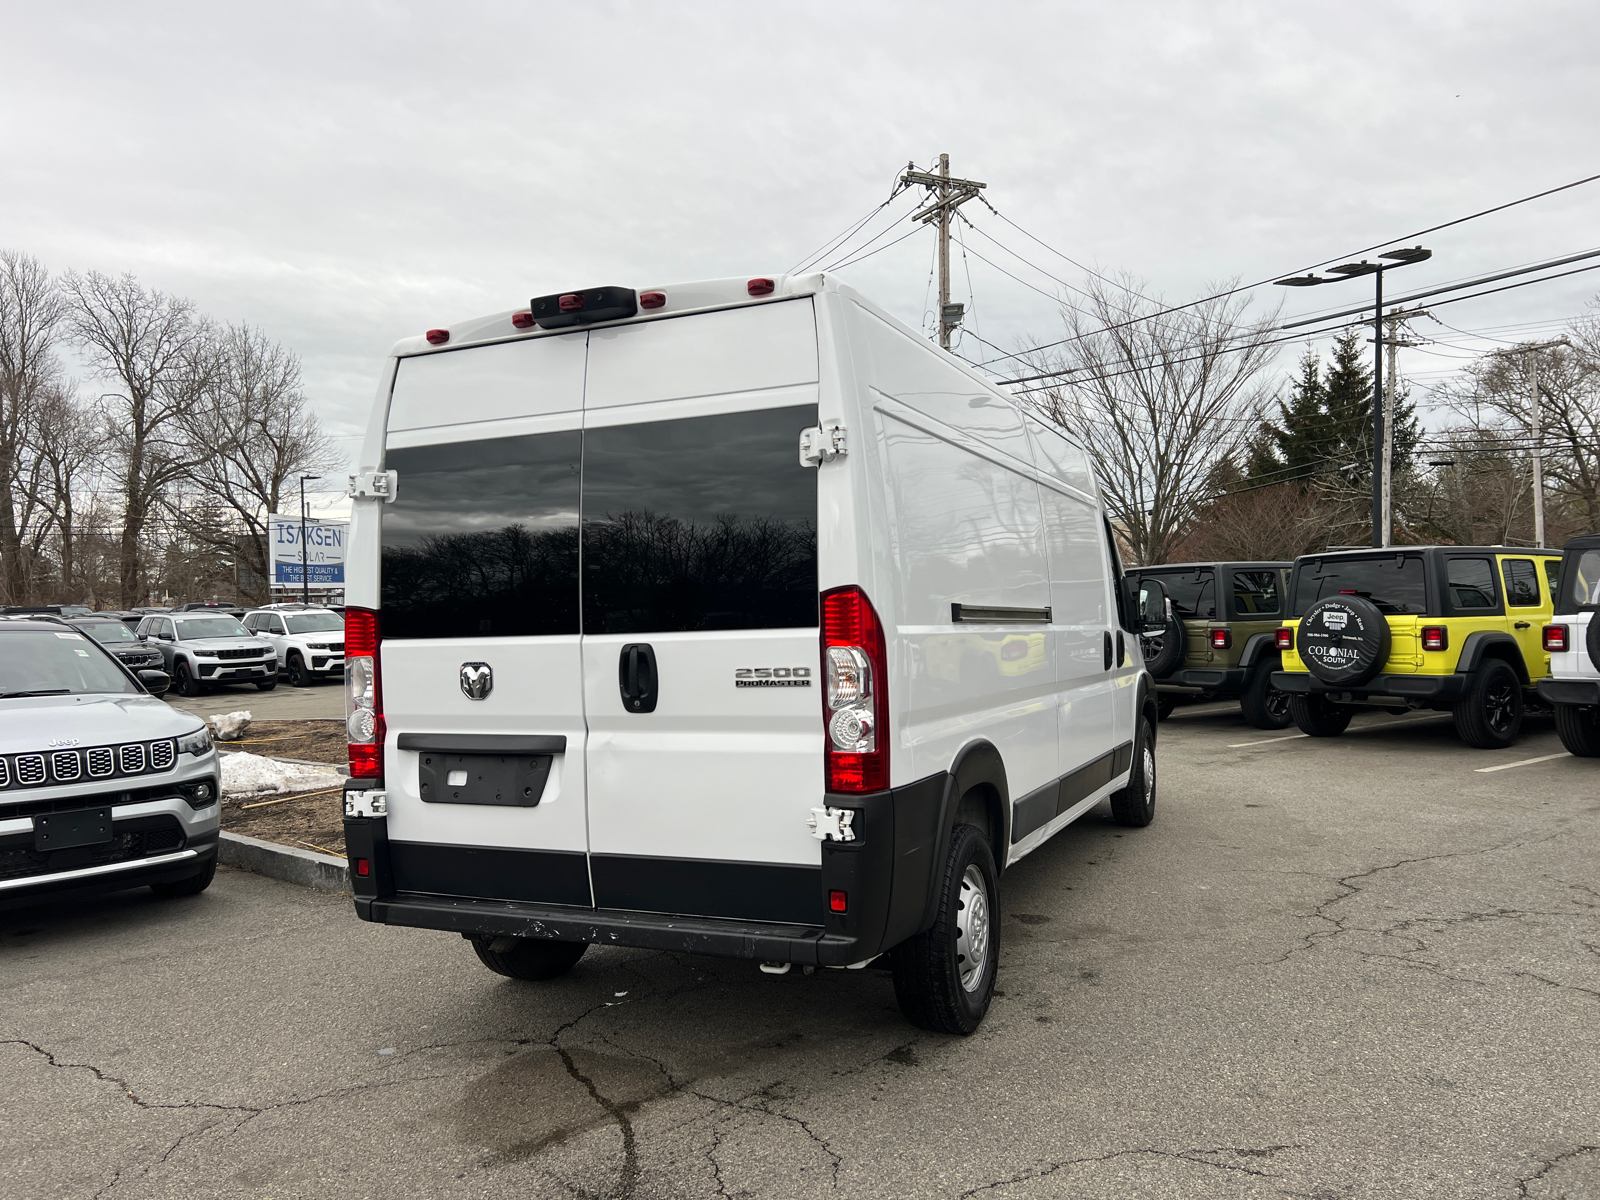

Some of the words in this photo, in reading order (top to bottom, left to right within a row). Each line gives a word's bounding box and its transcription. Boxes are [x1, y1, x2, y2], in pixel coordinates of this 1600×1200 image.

[277, 524, 341, 547] ISAKSEN
[1306, 607, 1322, 627] Chrysler
[1344, 606, 1355, 616] Jeep
[1356, 617, 1365, 631] Ram
[1327, 613, 1344, 622] Jeep
[1308, 646, 1359, 658] COLONIAL
[735, 667, 811, 679] 2500
[48, 738, 80, 747] Jeep
